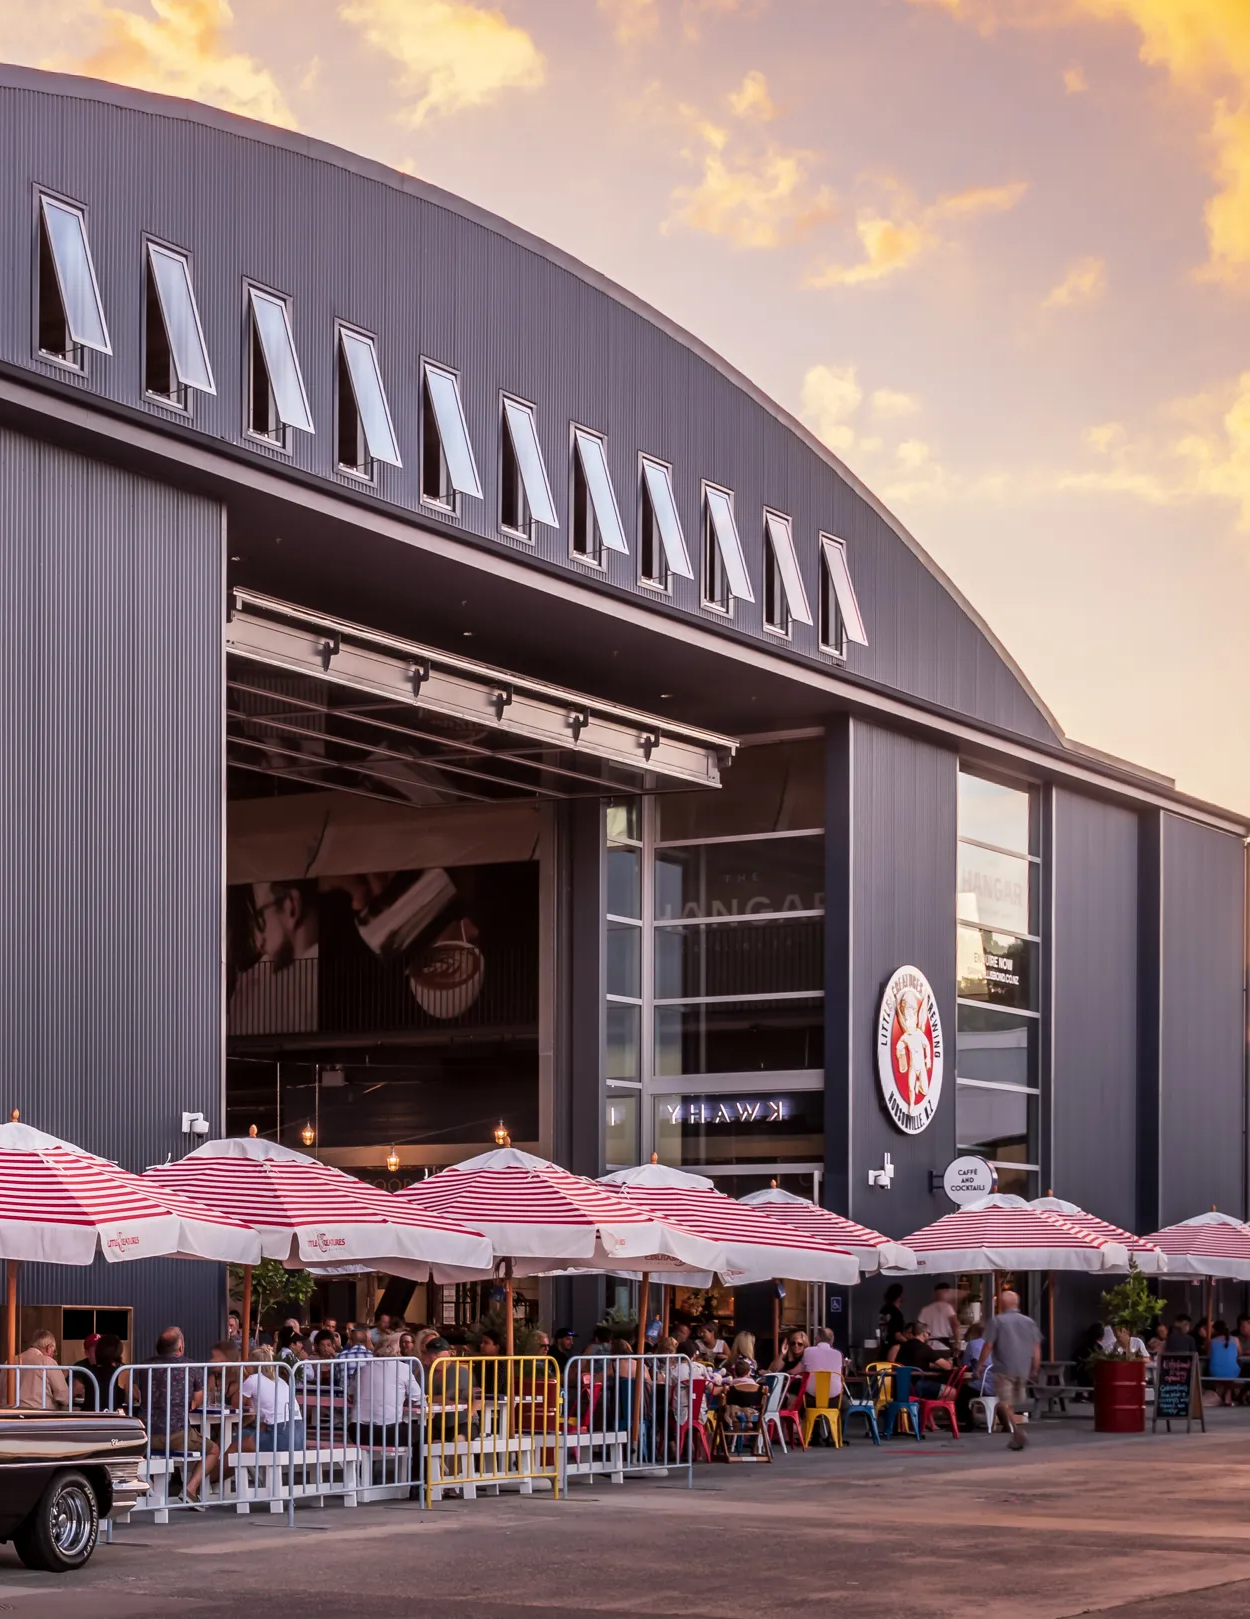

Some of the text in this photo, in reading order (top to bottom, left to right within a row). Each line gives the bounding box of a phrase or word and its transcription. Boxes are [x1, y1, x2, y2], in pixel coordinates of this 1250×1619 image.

[723, 872, 760, 884] THE
[998, 957, 1013, 971] NOW
[881, 998, 894, 1047] LITTLE
[891, 974, 923, 996] CREATURES
